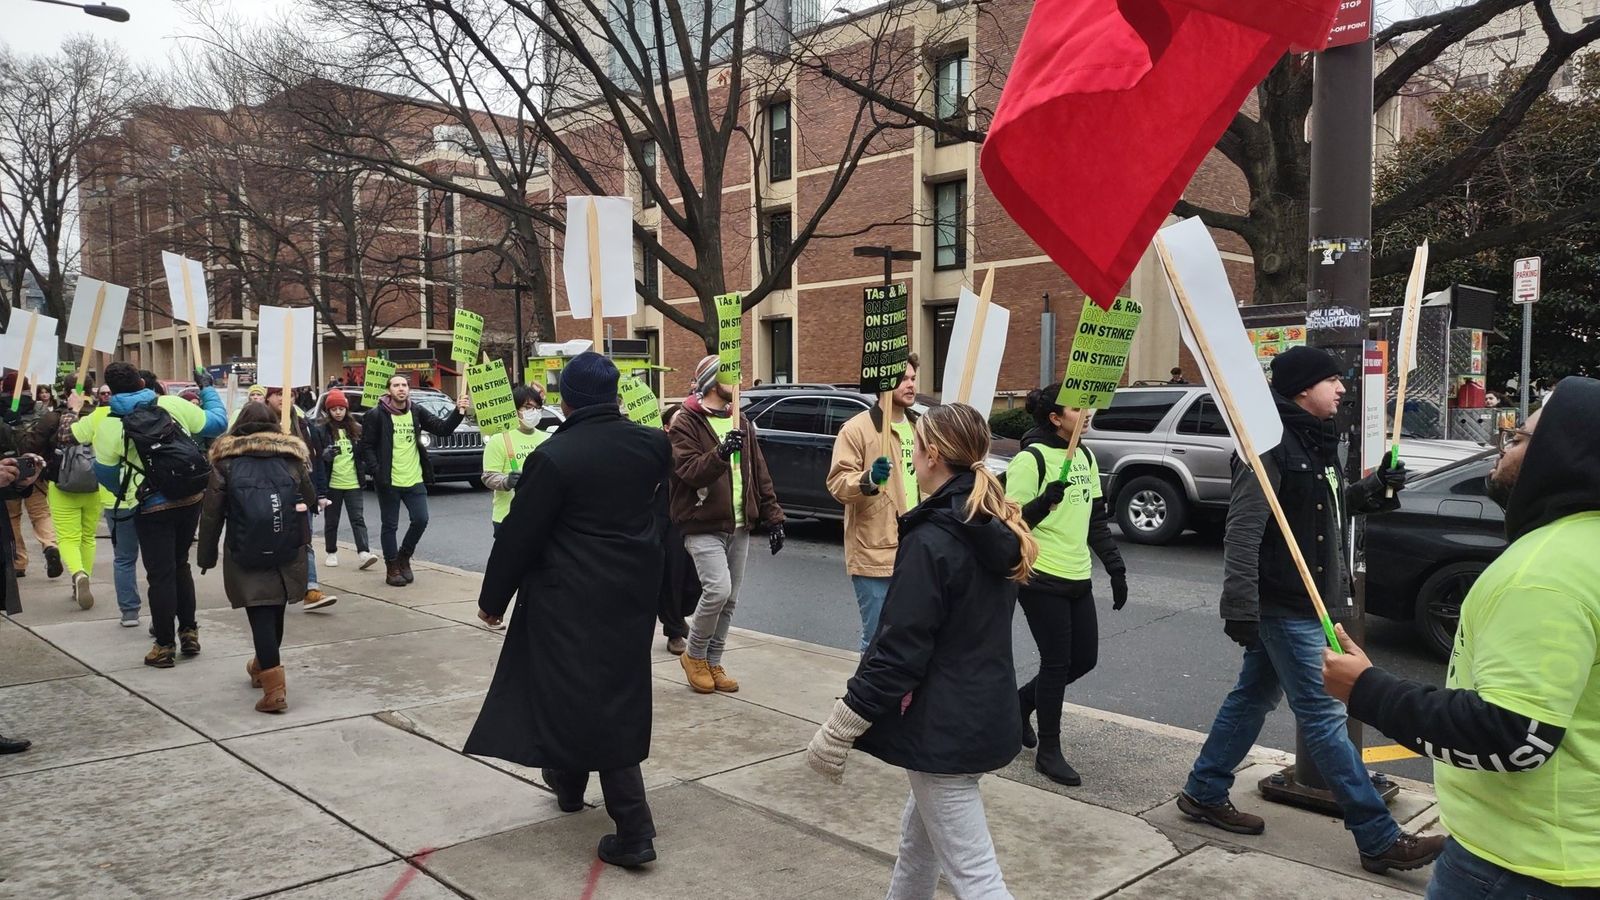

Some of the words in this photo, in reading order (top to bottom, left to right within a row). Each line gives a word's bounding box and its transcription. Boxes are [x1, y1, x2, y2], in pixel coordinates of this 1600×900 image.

[1340, 0, 1362, 10] STOP
[865, 288, 884, 300] TAs
[889, 286, 896, 298] &
[717, 297, 732, 306] TAs
[1113, 299, 1122, 310] &
[1125, 301, 1142, 314] RAs
[720, 319, 730, 328] ON
[866, 314, 880, 327] ON
[1080, 322, 1097, 335] ON
[1098, 326, 1134, 340] STRIKE!
[720, 341, 730, 350] ON
[865, 341, 880, 353] ON
[1072, 350, 1088, 362] ON
[1090, 353, 1126, 367] STRIKE!
[467, 368, 482, 376] TAs
[720, 363, 730, 372] ON
[862, 367, 878, 378] ON
[472, 385, 483, 393] ON
[621, 384, 632, 392] TAs
[1066, 378, 1081, 390] ON
[1082, 380, 1117, 392] STRIKE!
[476, 402, 488, 410] ON
[627, 402, 636, 410] ON
[480, 419, 492, 427] ON
[270, 493, 280, 513] YEAR
[273, 515, 281, 532] CITY
